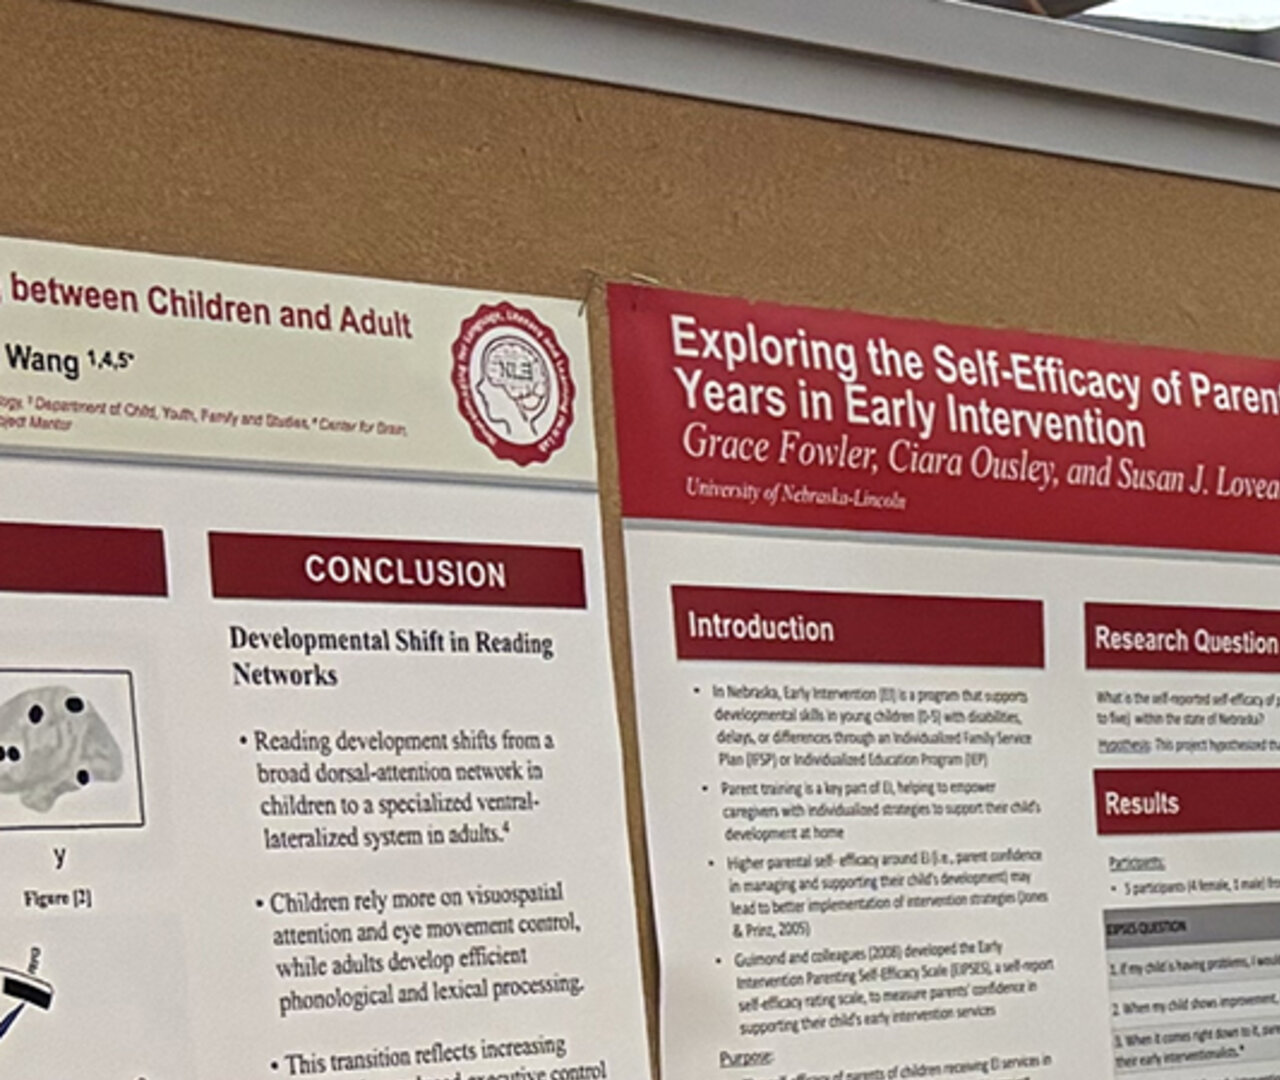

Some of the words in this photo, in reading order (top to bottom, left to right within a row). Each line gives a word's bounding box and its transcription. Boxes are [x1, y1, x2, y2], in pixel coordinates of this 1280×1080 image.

[11, 272, 138, 312] between
[148, 286, 270, 325] Children
[280, 304, 331, 330] and
[340, 306, 412, 339] Adult
[5, 344, 79, 380] Wang
[672, 315, 857, 382] Exploring
[867, 338, 923, 379] the
[933, 345, 1140, 410] Self-Efficacy
[1152, 370, 1181, 405] of
[674, 367, 786, 416] Years
[799, 379, 832, 420] in
[843, 380, 935, 437] Early
[947, 394, 1145, 447] Intervention
[684, 422, 769, 461] Grace
[779, 430, 877, 473] Fowler,
[889, 439, 962, 475] Ciara
[971, 446, 1058, 489] Ousley,
[1067, 456, 1112, 486] and
[1117, 458, 1184, 492] Susan
[1192, 464, 1208, 494] J.
[687, 477, 760, 504] University
[763, 483, 780, 505] of
[304, 553, 507, 589] CONCLUSION
[687, 611, 835, 642] Introduction
[1095, 626, 1189, 653] Research
[1194, 629, 1279, 656] Question
[230, 626, 390, 655] Developmental
[396, 629, 444, 651] Shift
[450, 631, 469, 652] in
[476, 631, 553, 659] Reading
[233, 663, 338, 688] Networks
[254, 730, 332, 756] Reading
[336, 730, 448, 756] development
[452, 730, 497, 750] shifts
[502, 730, 541, 749] from
[544, 735, 554, 749] a
[257, 762, 310, 783] broad
[315, 762, 452, 783] dorsal-attention
[456, 760, 523, 780] network
[527, 760, 543, 780] in
[261, 794, 336, 816] children
[341, 798, 359, 815] to
[363, 799, 374, 814] a
[379, 792, 473, 819] specialized
[477, 791, 539, 811] ventral-
[1105, 791, 1180, 815] Results
[264, 826, 359, 849] lateralized
[363, 830, 423, 851] system
[427, 830, 445, 845] in
[53, 843, 66, 869] y
[270, 891, 349, 914] Children
[354, 889, 387, 914] rely
[392, 893, 436, 908] more
[440, 891, 462, 906] on
[467, 881, 563, 908] visuospatial
